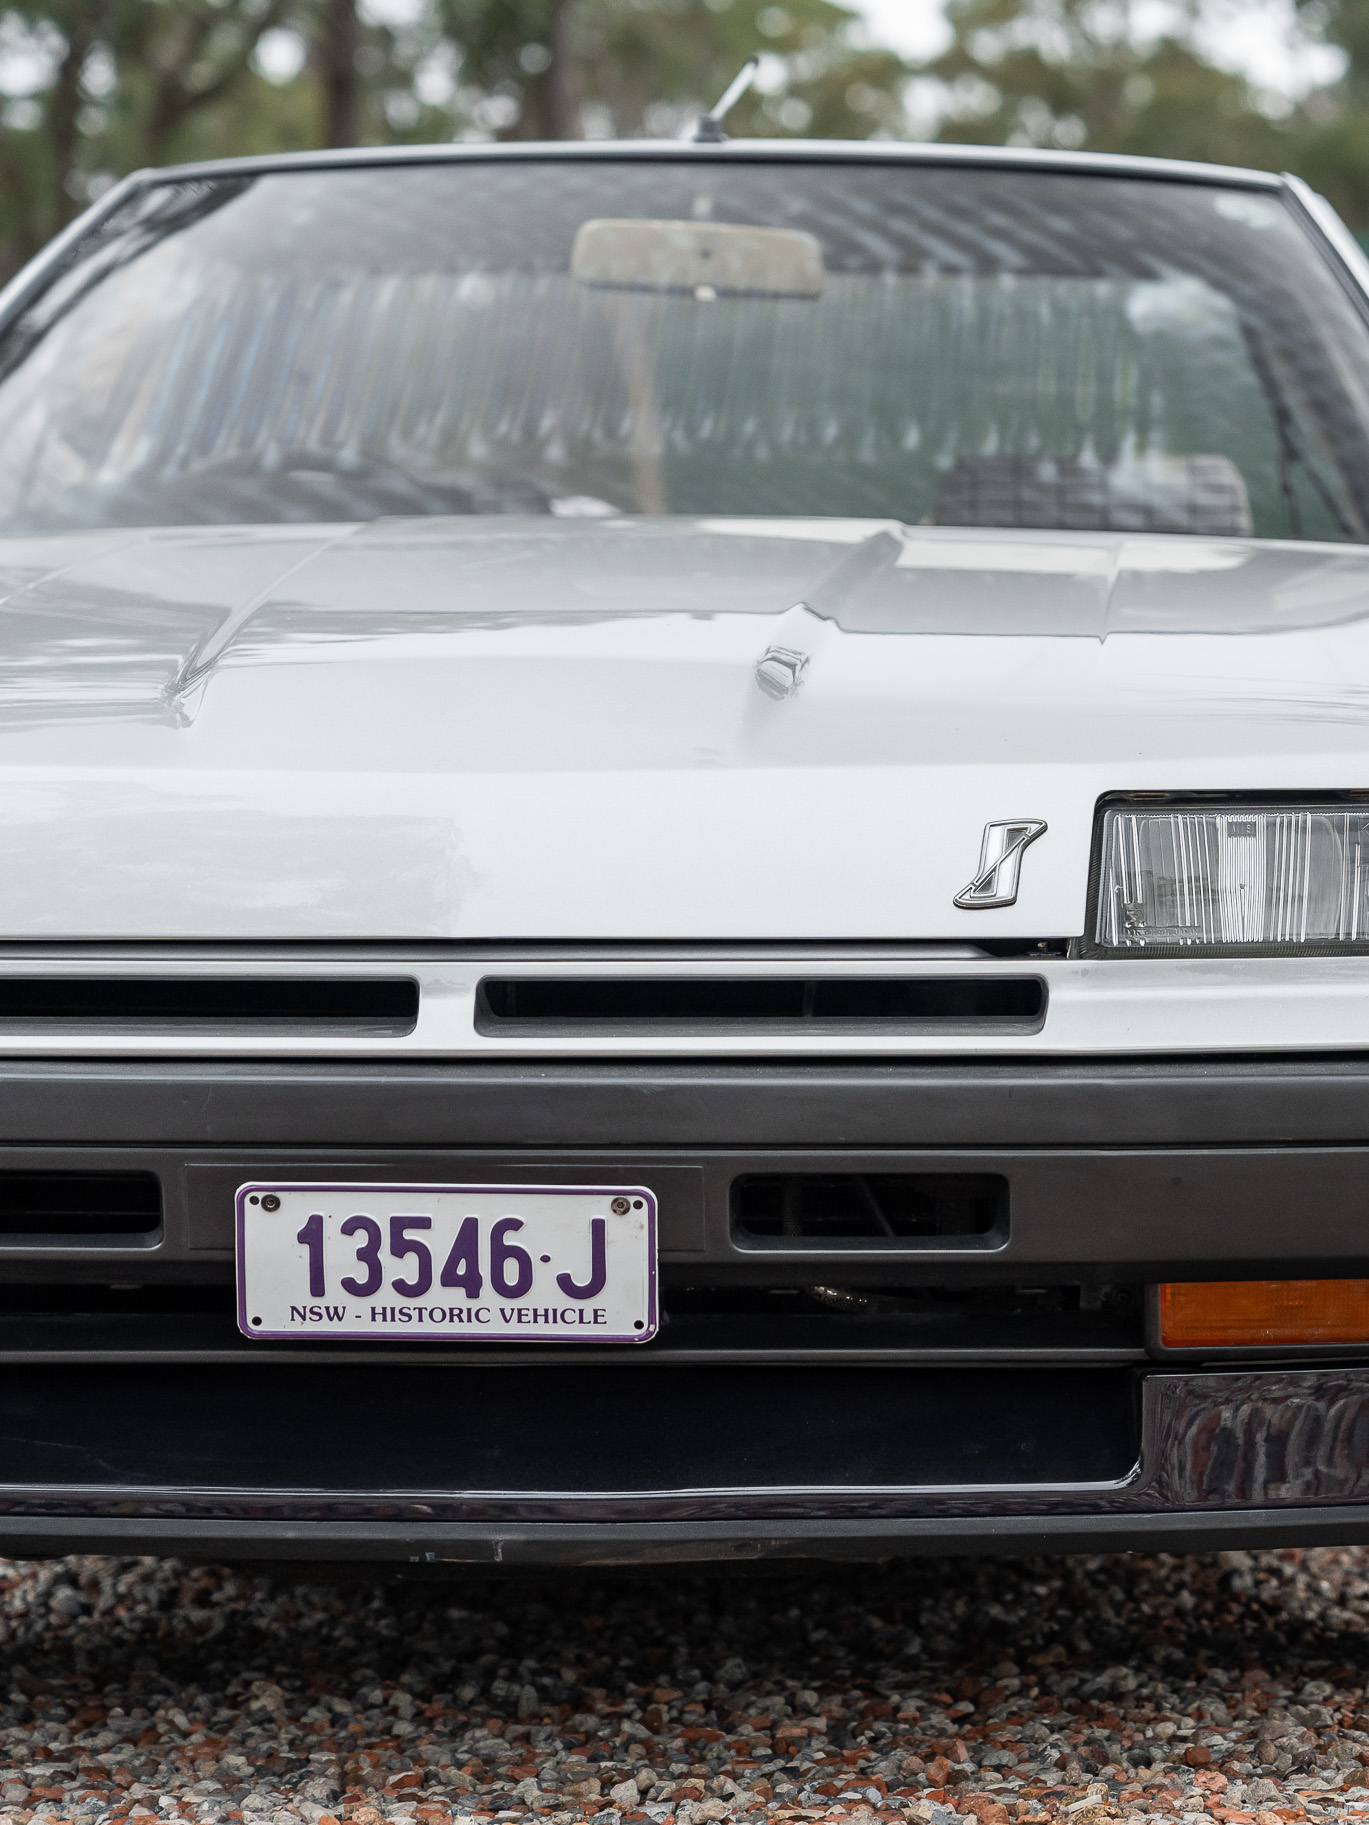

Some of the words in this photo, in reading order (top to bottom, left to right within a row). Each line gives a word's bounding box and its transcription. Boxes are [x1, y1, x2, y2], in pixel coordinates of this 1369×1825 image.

[289, 1305, 347, 1323] NSW
[369, 1306, 492, 1324] HISTORIC
[498, 1307, 608, 1326] VEHICLE
